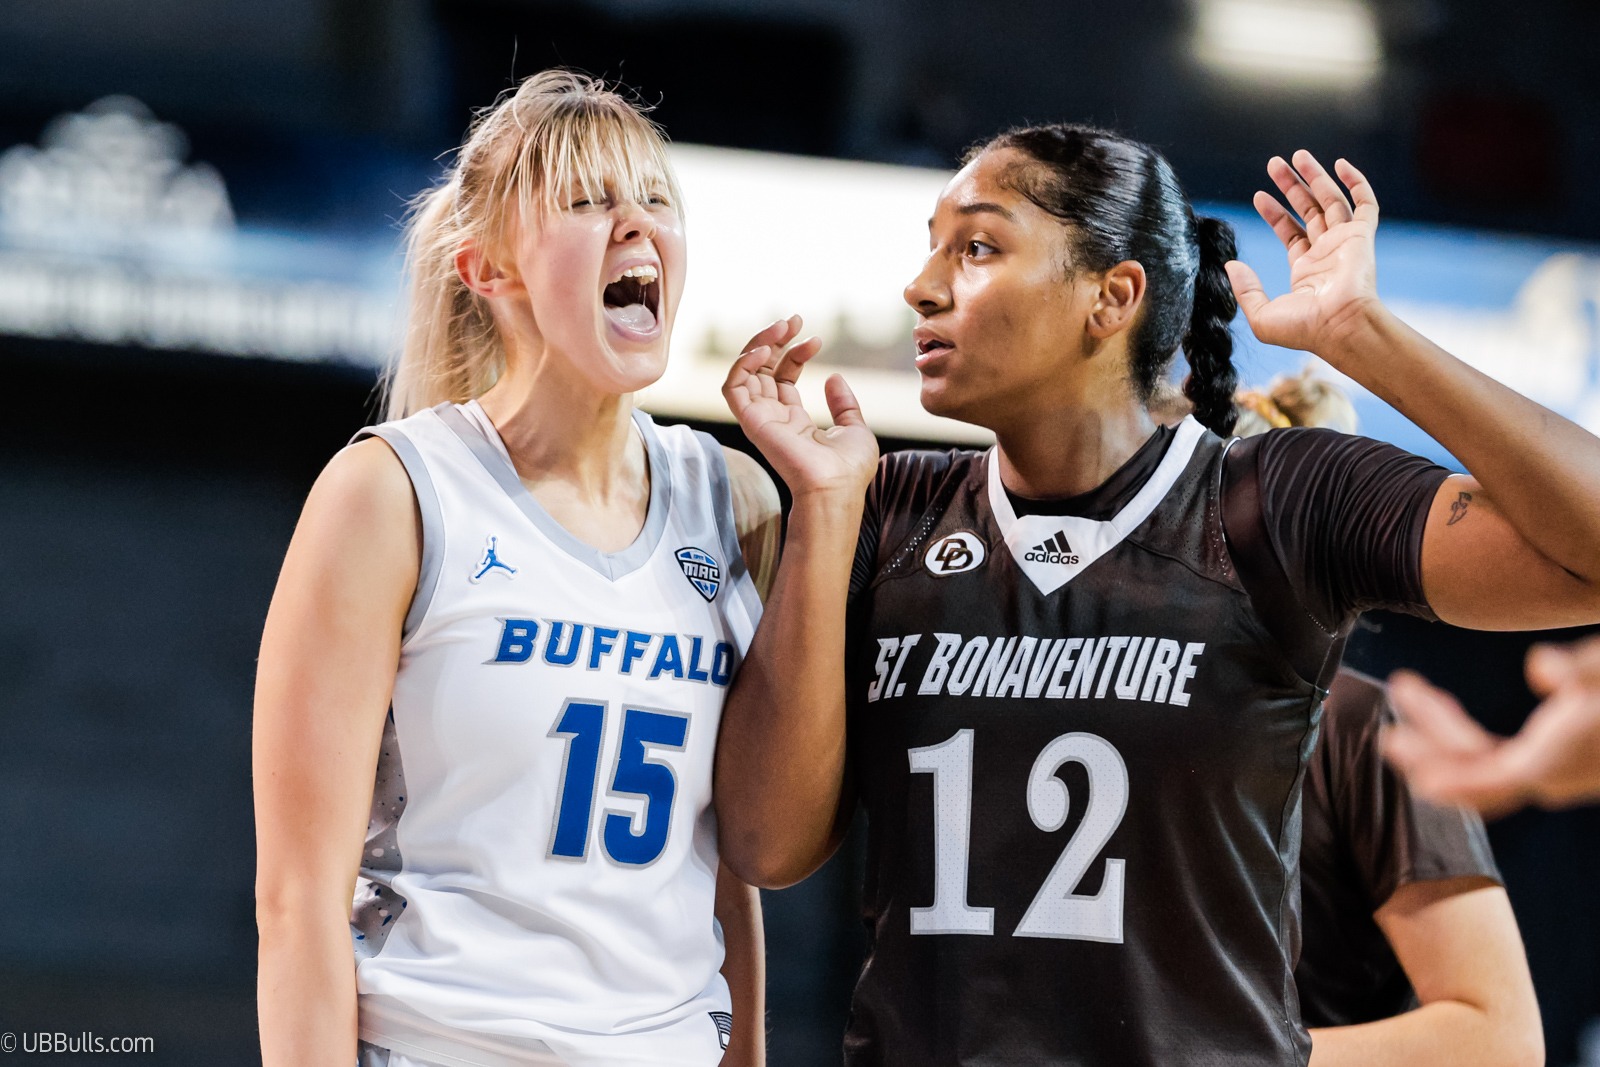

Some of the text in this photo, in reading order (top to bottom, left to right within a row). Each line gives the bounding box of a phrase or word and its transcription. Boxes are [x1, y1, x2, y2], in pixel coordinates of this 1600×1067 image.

[682, 562, 720, 582] MAC
[1024, 551, 1080, 566] adidas
[482, 617, 735, 688] BUFFALO
[868, 632, 1206, 707] ST. BONAVENTURE
[545, 697, 692, 870] 15
[907, 728, 1130, 945] 12
